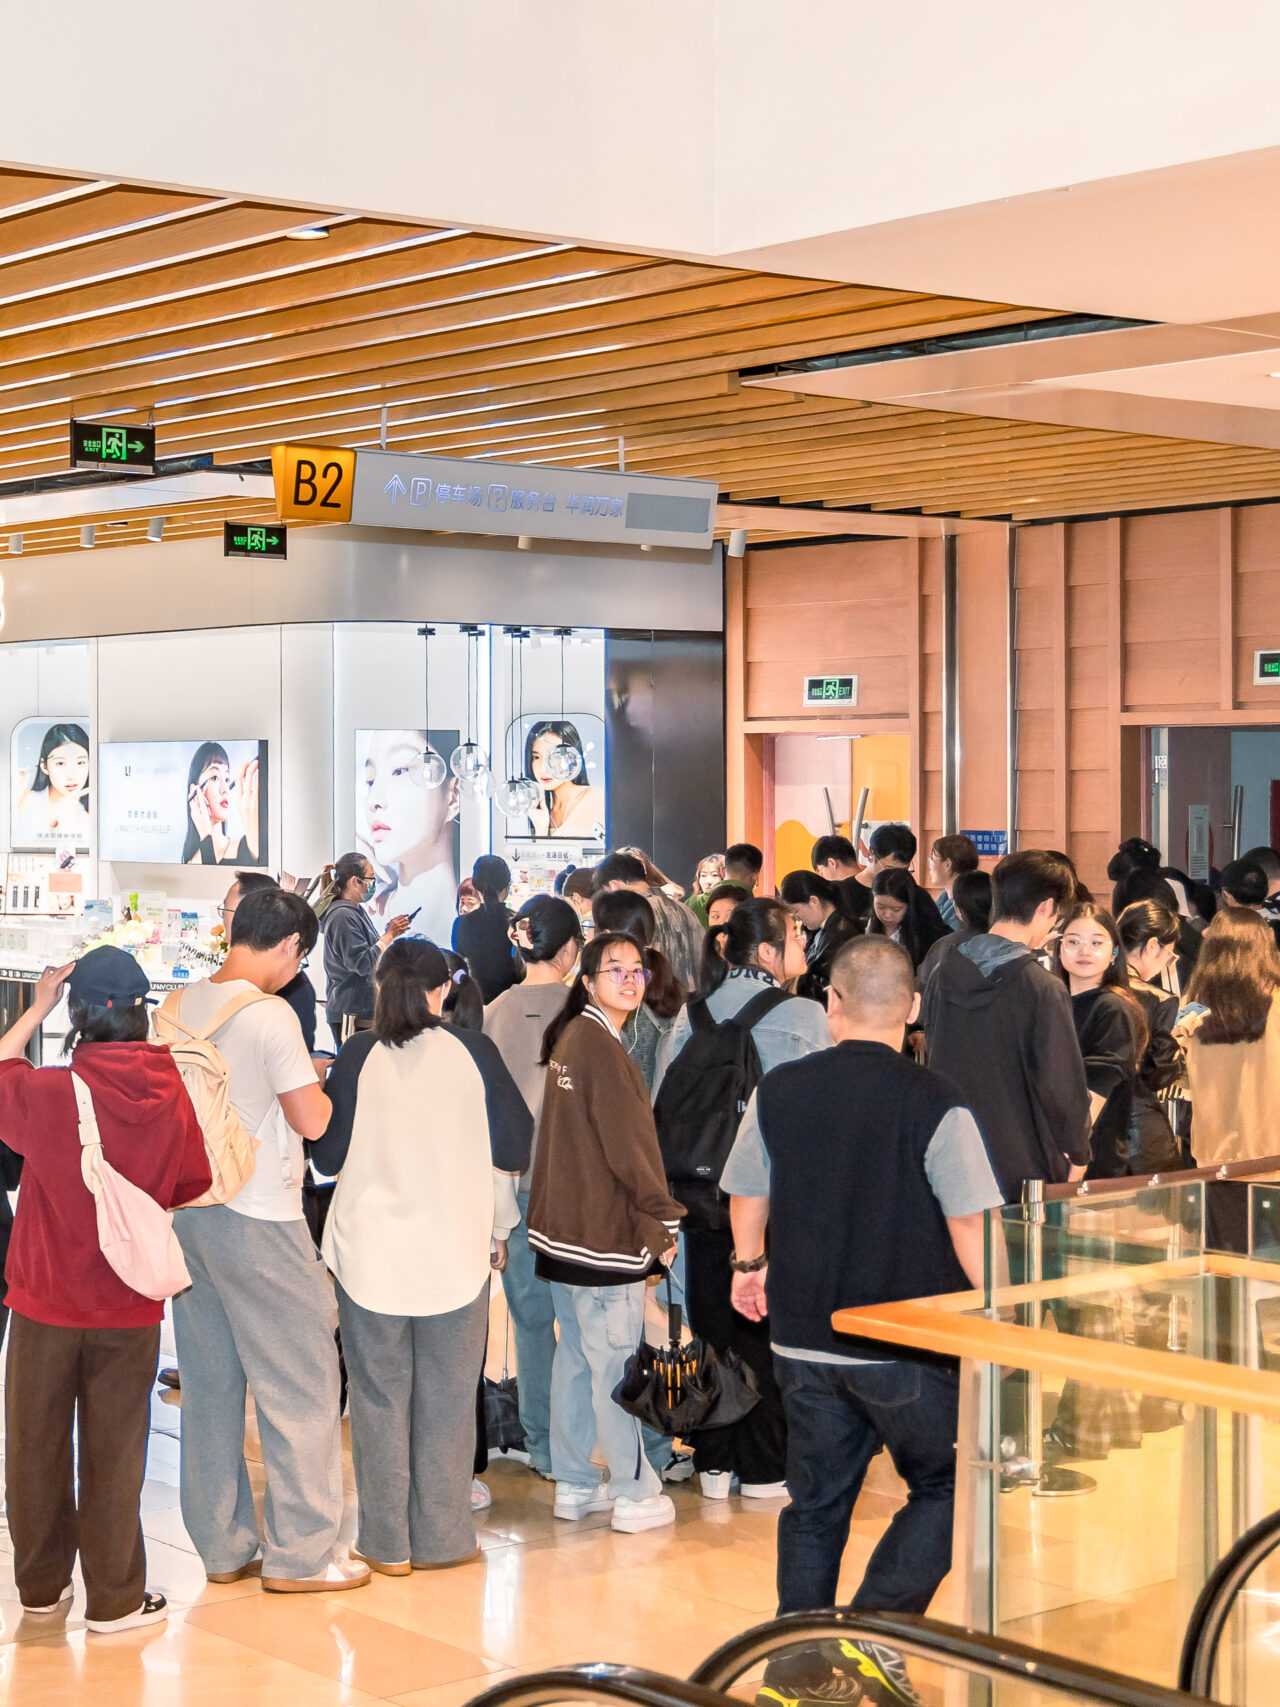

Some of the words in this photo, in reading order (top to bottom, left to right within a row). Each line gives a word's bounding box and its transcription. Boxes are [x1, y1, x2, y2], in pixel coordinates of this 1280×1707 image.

[293, 459, 344, 509] B2
[434, 483, 483, 507] 停车场
[510, 489, 556, 513] 服务台
[565, 494, 625, 518] 华润万家
